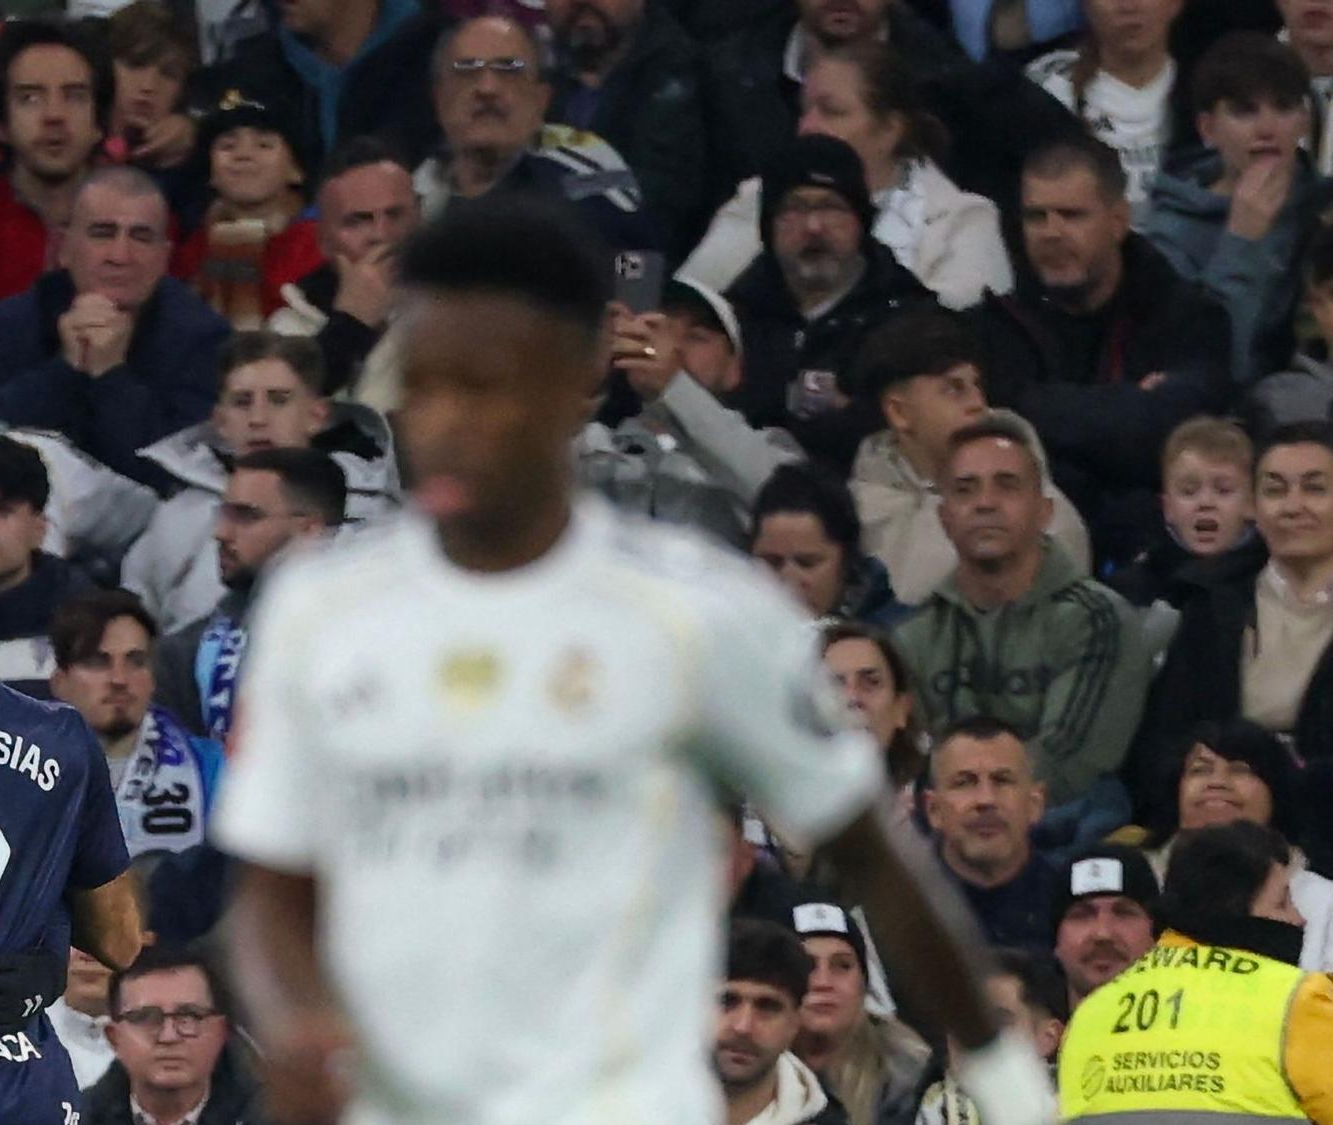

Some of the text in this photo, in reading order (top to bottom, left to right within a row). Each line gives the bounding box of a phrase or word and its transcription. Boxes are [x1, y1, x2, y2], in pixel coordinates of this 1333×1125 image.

[1110, 988, 1184, 1034] 201
[1112, 1050, 1222, 1071] SERVICIOS
[1104, 1073, 1226, 1094] AUXILIARES
